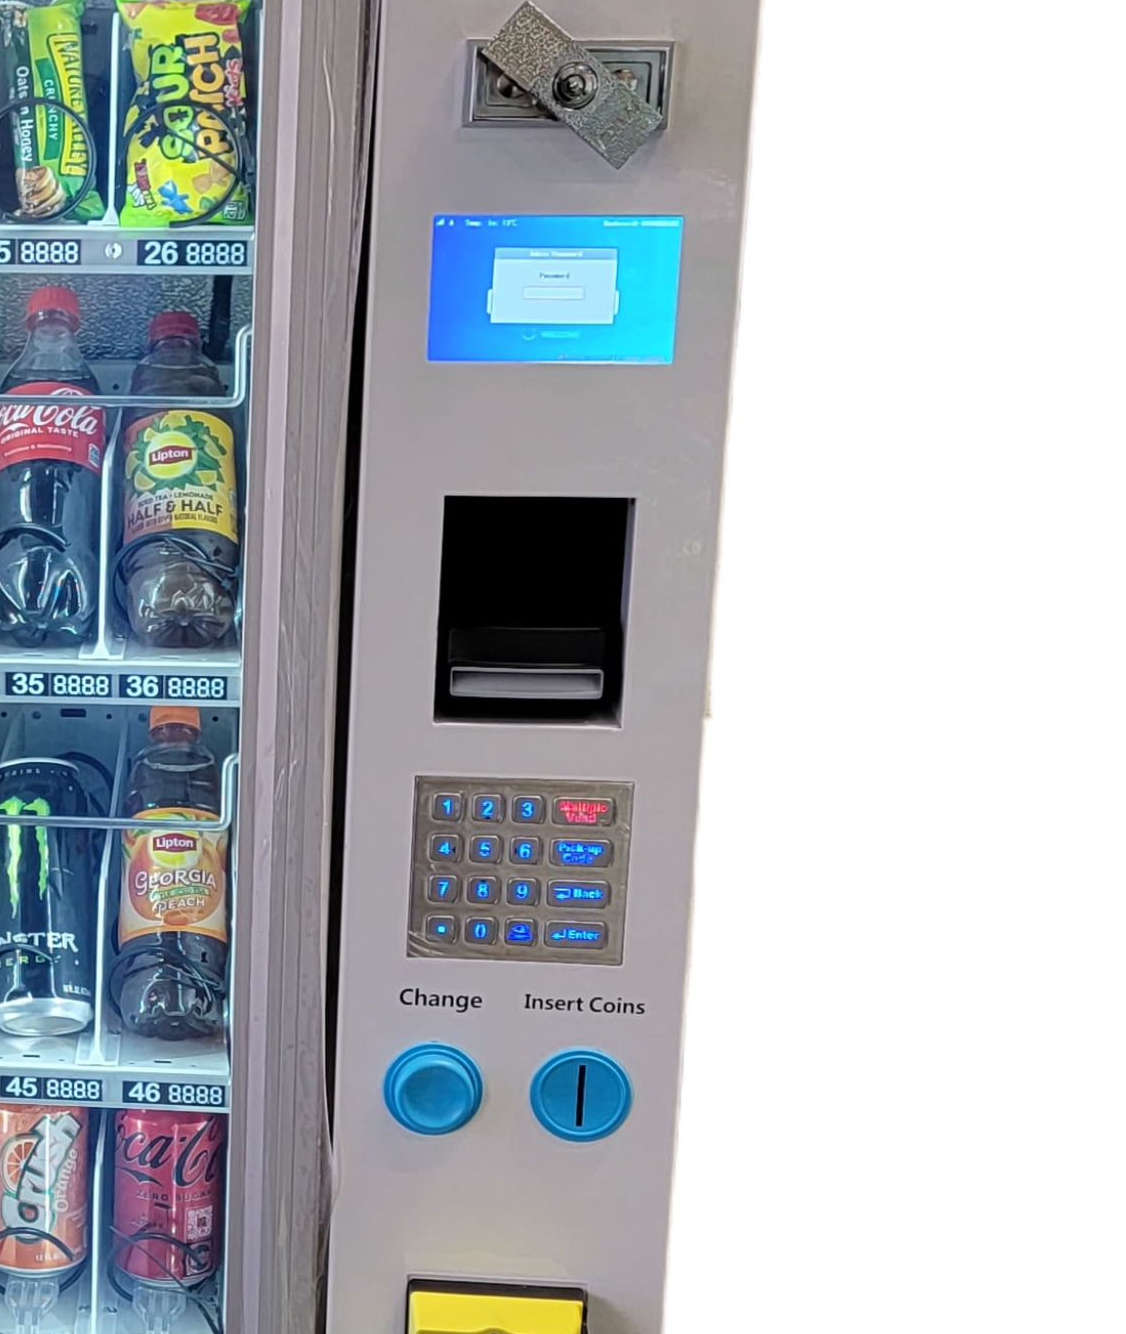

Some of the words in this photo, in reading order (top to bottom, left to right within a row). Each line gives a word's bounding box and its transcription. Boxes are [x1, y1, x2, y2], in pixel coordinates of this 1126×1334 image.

[16, 67, 30, 99] Oats
[151, 45, 194, 160] SOUR
[20, 119, 34, 162] Honey
[144, 242, 177, 263] 26
[0, 427, 44, 444] ORIGINAL
[46, 426, 79, 438] TASTE
[151, 449, 189, 462] Lipton
[155, 494, 168, 502] TEA
[174, 492, 214, 501] LEMONADE
[127, 504, 162, 526] HALF
[166, 501, 176, 513] &
[181, 499, 223, 516] HALF
[12, 674, 43, 694] 35
[126, 676, 158, 696] 36
[442, 800, 452, 815] 1
[482, 800, 493, 816] 2
[522, 801, 533, 817] 3
[156, 838, 194, 850] Lipton
[438, 842, 451, 855] 4
[479, 842, 491, 857] 5
[518, 843, 531, 859] 6
[558, 841, 604, 856] Pick-up
[561, 852, 595, 864] Code
[134, 869, 217, 896] GEORGIA
[437, 881, 450, 898] 7
[477, 881, 489, 899] 8
[516, 884, 528, 900] 9
[572, 888, 603, 900] Back
[153, 897, 206, 917] PEACH
[474, 923, 486, 938] 0
[568, 929, 600, 941] Enter
[399, 988, 483, 1013] Change
[524, 993, 583, 1012] Insert
[589, 997, 646, 1015] Coins
[5, 1077, 37, 1097] 45
[128, 1082, 160, 1102] 46
[0, 1111, 83, 1240] Crush
[53, 1148, 78, 1213] Orange
[136, 1189, 170, 1202] ZERO
